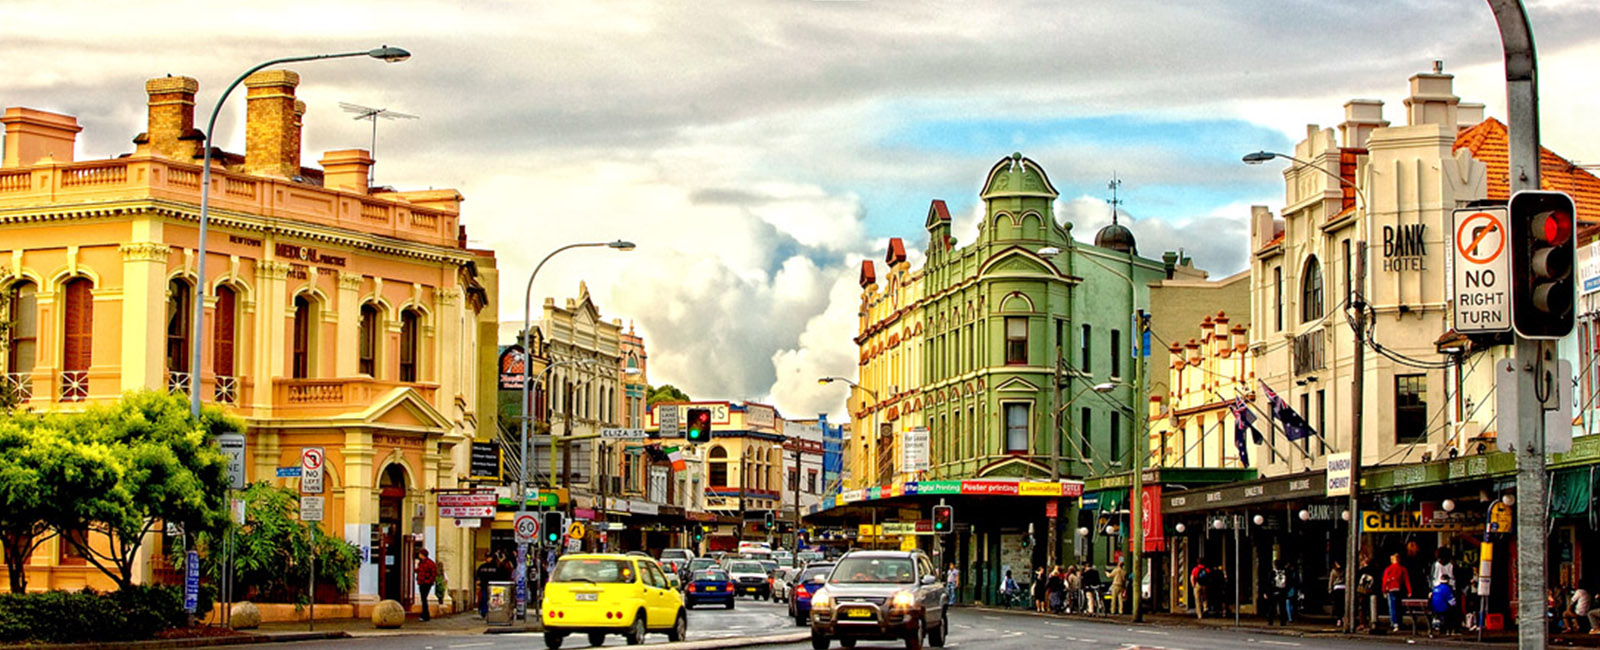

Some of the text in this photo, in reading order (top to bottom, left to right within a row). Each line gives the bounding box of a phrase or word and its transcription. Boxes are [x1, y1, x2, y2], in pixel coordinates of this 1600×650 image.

[1383, 223, 1427, 257] BANK
[275, 243, 319, 263] MEDICAL
[1383, 256, 1427, 272] HOTEL
[1465, 269, 1496, 288] NO
[1460, 292, 1504, 306] RIGHT
[1461, 310, 1502, 324] TURN
[603, 429, 643, 437] ELIZA ST
[1329, 459, 1351, 472] RAINBOW
[305, 470, 319, 478] NO
[918, 484, 935, 493] Digital
[935, 483, 960, 493] Printing
[963, 483, 1018, 493] Poster printing
[1020, 484, 1060, 493] Laminating
[1329, 476, 1349, 489] CHEMIST
[1308, 504, 1330, 521] BANK
[519, 521, 535, 533] 60
